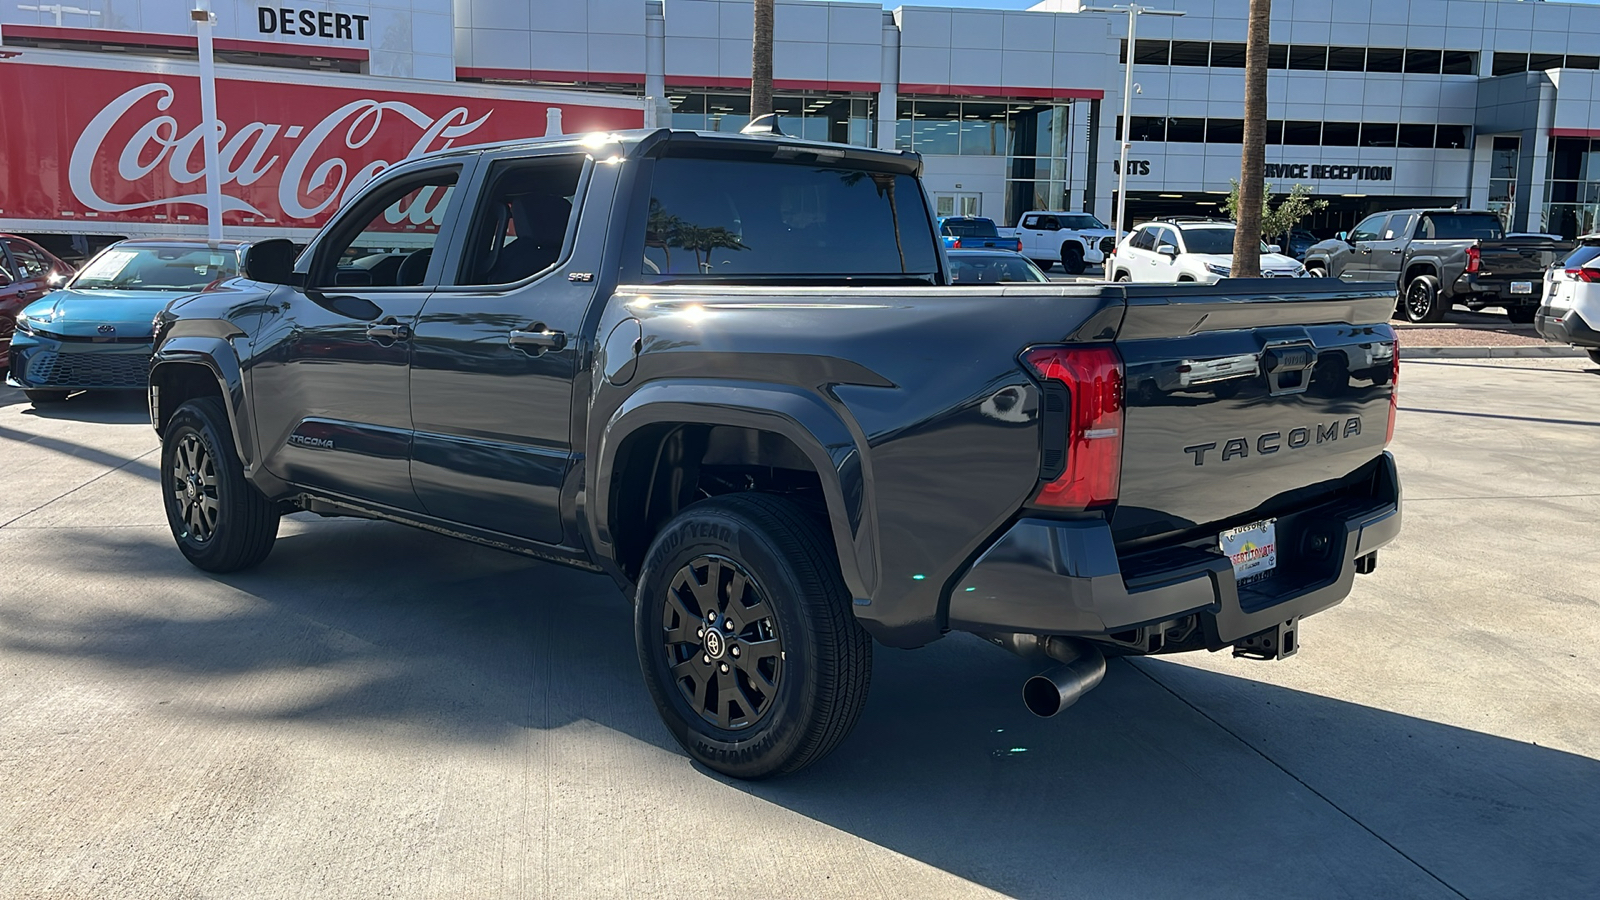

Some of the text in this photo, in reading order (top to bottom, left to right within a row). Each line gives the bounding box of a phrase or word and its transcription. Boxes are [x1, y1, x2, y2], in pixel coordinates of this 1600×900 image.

[258, 7, 369, 40] DESERT
[1264, 163, 1392, 180] RVICE RECEPTION
[291, 434, 334, 448] TACOMA
[1183, 416, 1363, 467] TACOMA
[1230, 552, 1248, 565] SERT
